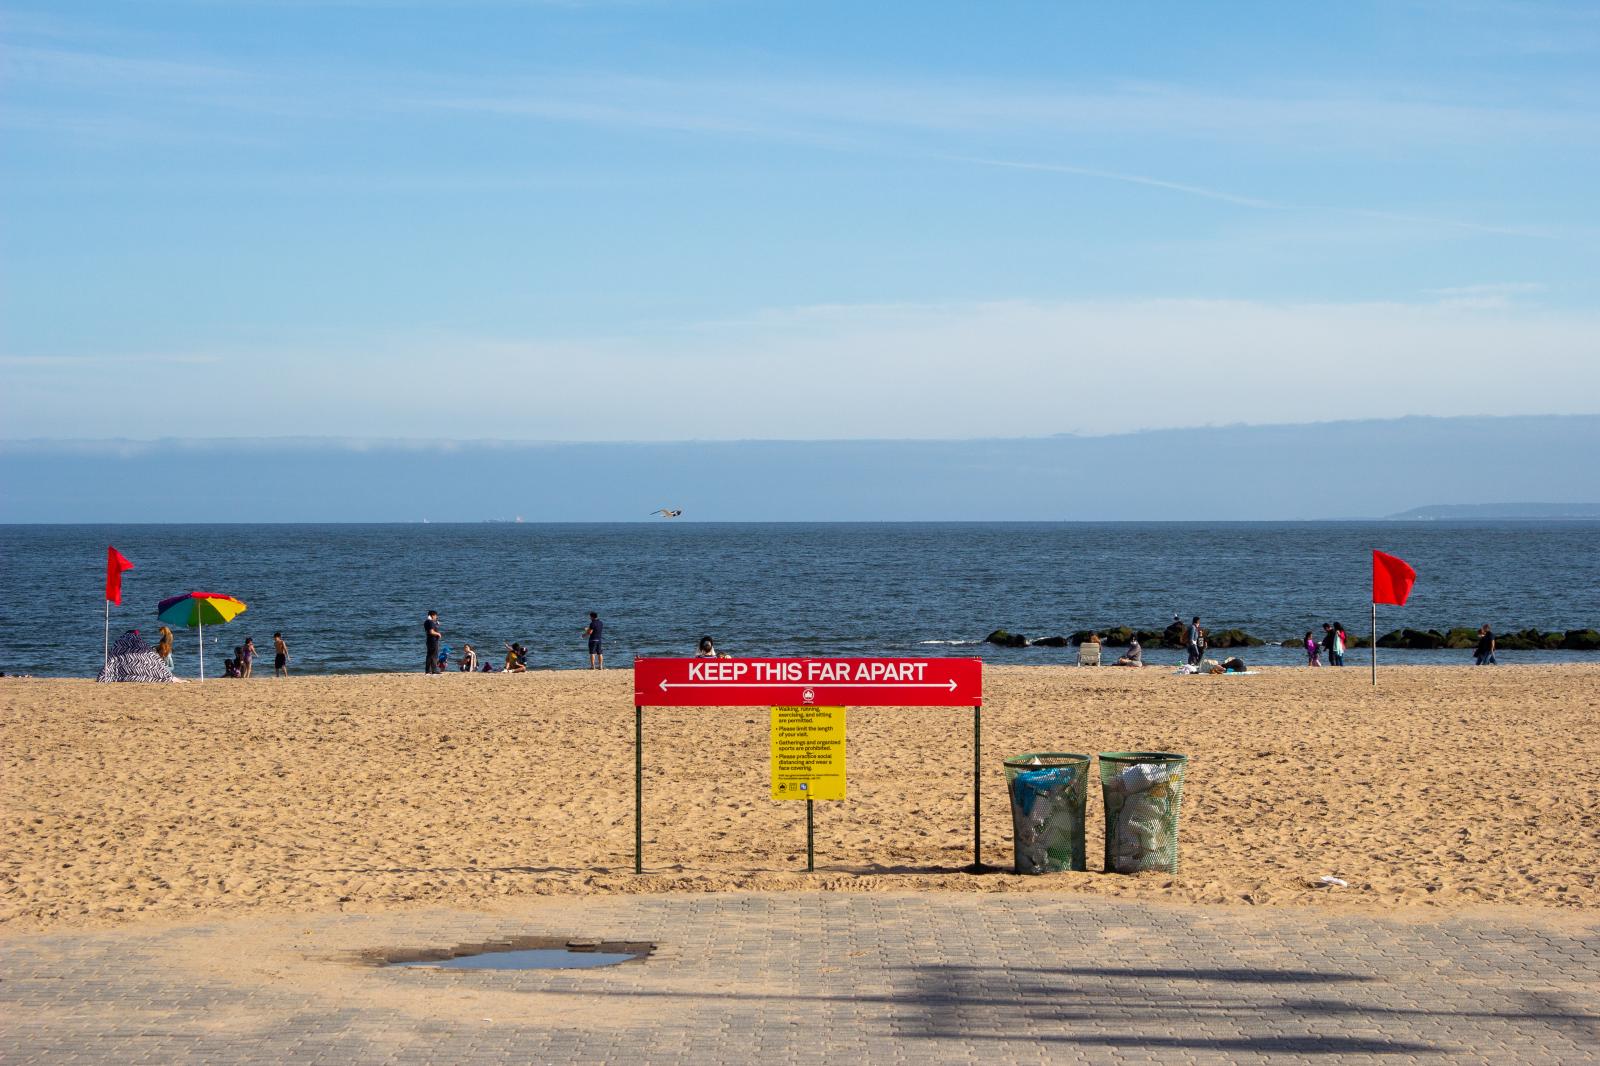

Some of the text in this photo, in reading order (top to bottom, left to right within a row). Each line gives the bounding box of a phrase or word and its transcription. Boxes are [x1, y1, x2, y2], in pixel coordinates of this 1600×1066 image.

[689, 663, 928, 681] KEEP THIS FAR APART
